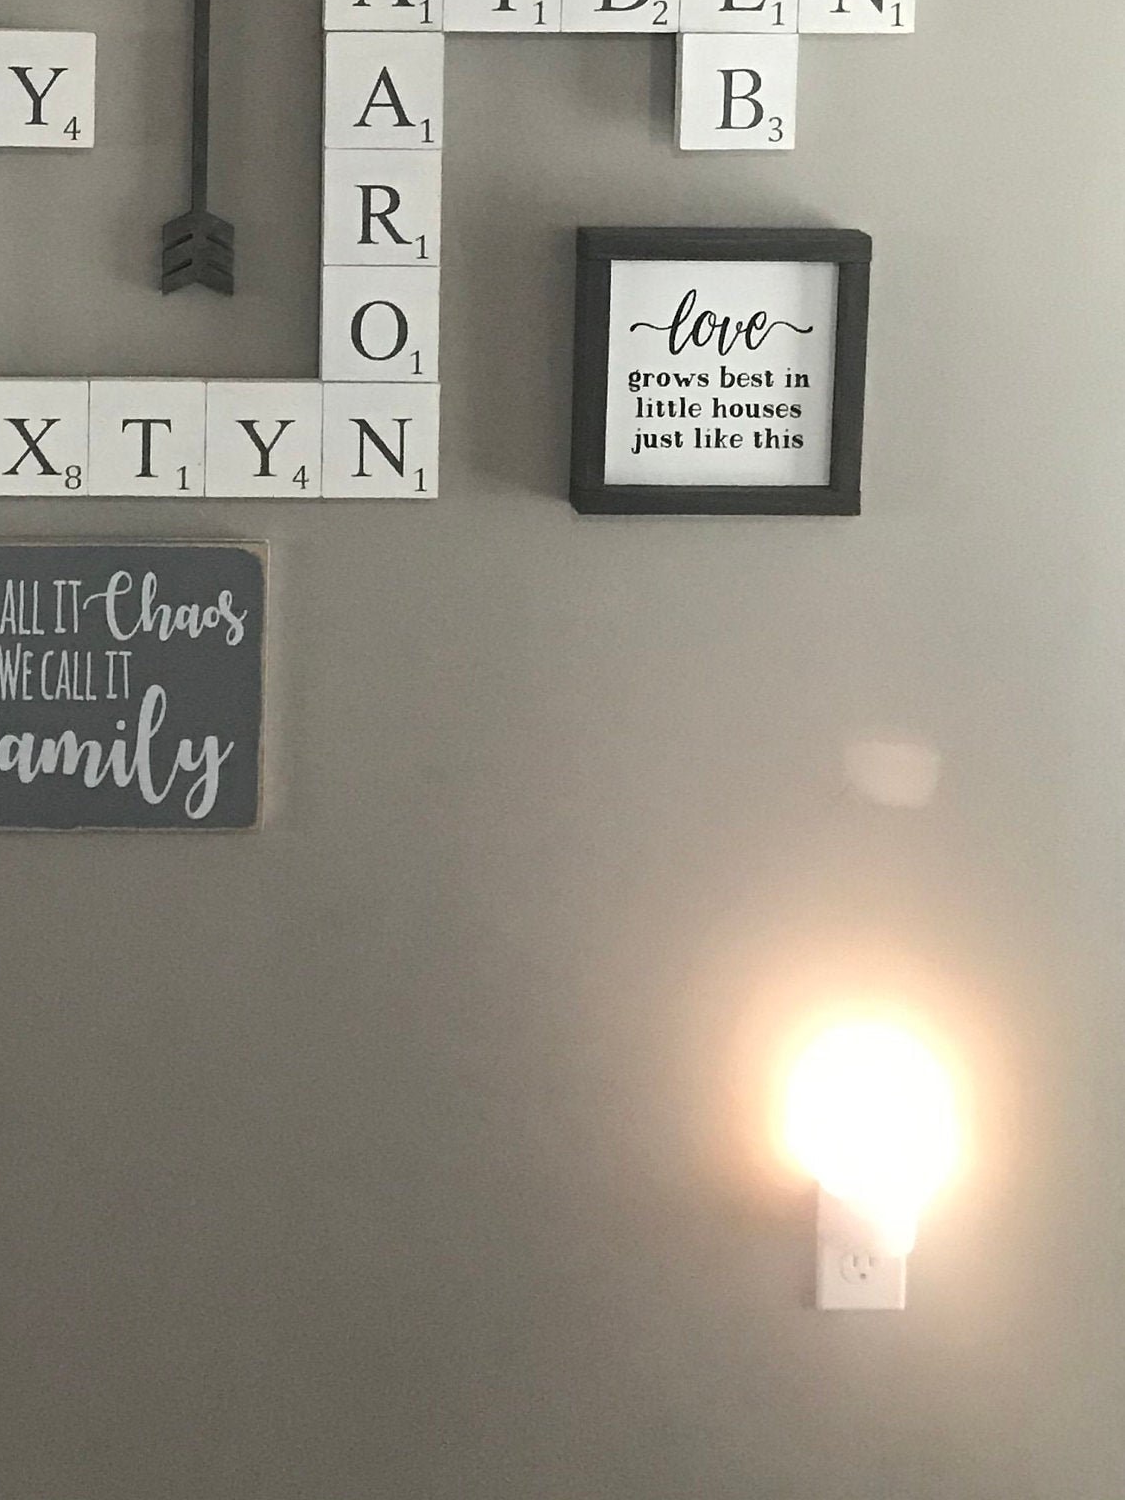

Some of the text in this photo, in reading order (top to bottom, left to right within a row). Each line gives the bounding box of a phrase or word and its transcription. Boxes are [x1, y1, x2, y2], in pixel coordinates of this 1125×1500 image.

[419, 0, 904, 27] 1 1 2 1 1
[62, 116, 82, 141] 4
[768, 116, 784, 143] 3
[410, 118, 435, 375] 1 1 1
[630, 289, 813, 356] love
[628, 366, 811, 392] grows best in
[635, 397, 803, 419] little houses
[631, 428, 804, 454] just like this
[64, 464, 82, 490] 8
[177, 465, 189, 491] 1
[292, 465, 310, 490] 4
[414, 467, 428, 492] 1
[53, 579, 82, 635] IT
[83, 570, 248, 646] Chaos
[40, 650, 97, 701] CALL
[105, 650, 132, 700] IT
